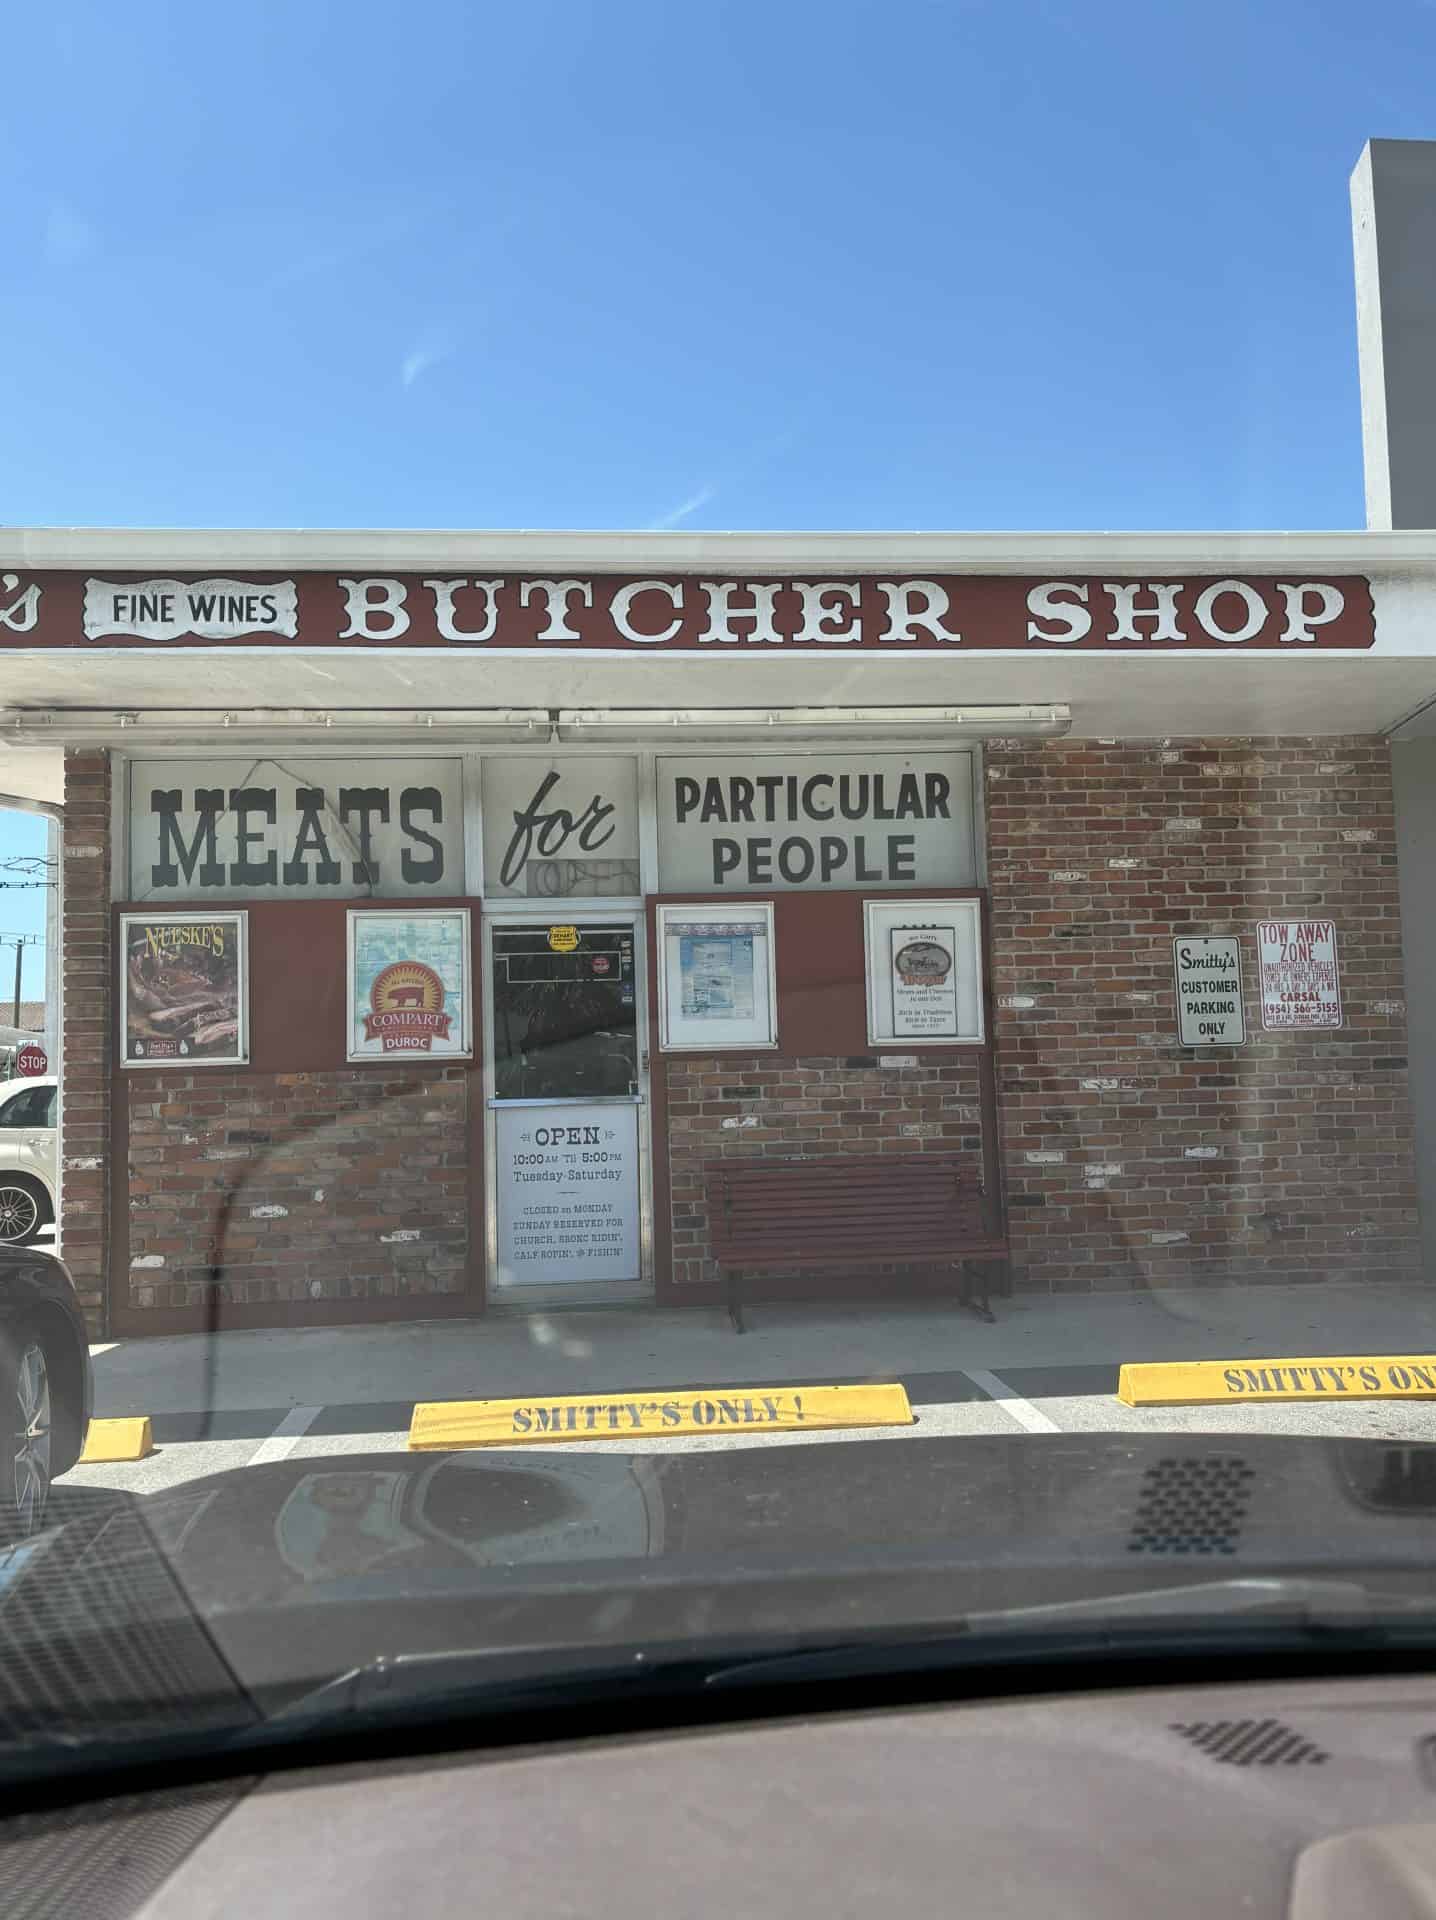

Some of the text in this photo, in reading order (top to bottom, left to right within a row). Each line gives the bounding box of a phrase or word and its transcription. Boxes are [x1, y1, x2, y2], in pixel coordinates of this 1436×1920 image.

[112, 593, 278, 625] FINE WINES
[337, 576, 1345, 644] BUTCHER SHOP
[674, 771, 951, 824] PARTICULAR
[150, 786, 444, 888] MEATS
[499, 770, 616, 889] for
[712, 833, 916, 885] PEOPLE
[1262, 924, 1331, 945] TOW AWAY
[1180, 947, 1236, 973] Smitty's
[1280, 943, 1316, 962] ZONE
[1181, 980, 1238, 994] CUSTOMER
[1280, 992, 1321, 1002] CARSAL
[1187, 1001, 1235, 1015] PARKING
[1265, 1002, 1337, 1015] (954) 566-5155
[372, 1012, 443, 1027] COMPART
[1198, 1022, 1226, 1036] ONLY
[386, 1036, 429, 1049] DUROC
[20, 1056, 46, 1070] STOP
[535, 1127, 601, 1146] OPEN
[567, 1168, 622, 1181] Saturday
[523, 1206, 559, 1215] CLOSED
[574, 1204, 614, 1214] MONDAY
[513, 1218, 623, 1231] SUNDAY RESERVED FOR
[1223, 1365, 1382, 1393] SMITTY'S
[512, 1400, 680, 1434] SMITTY'S
